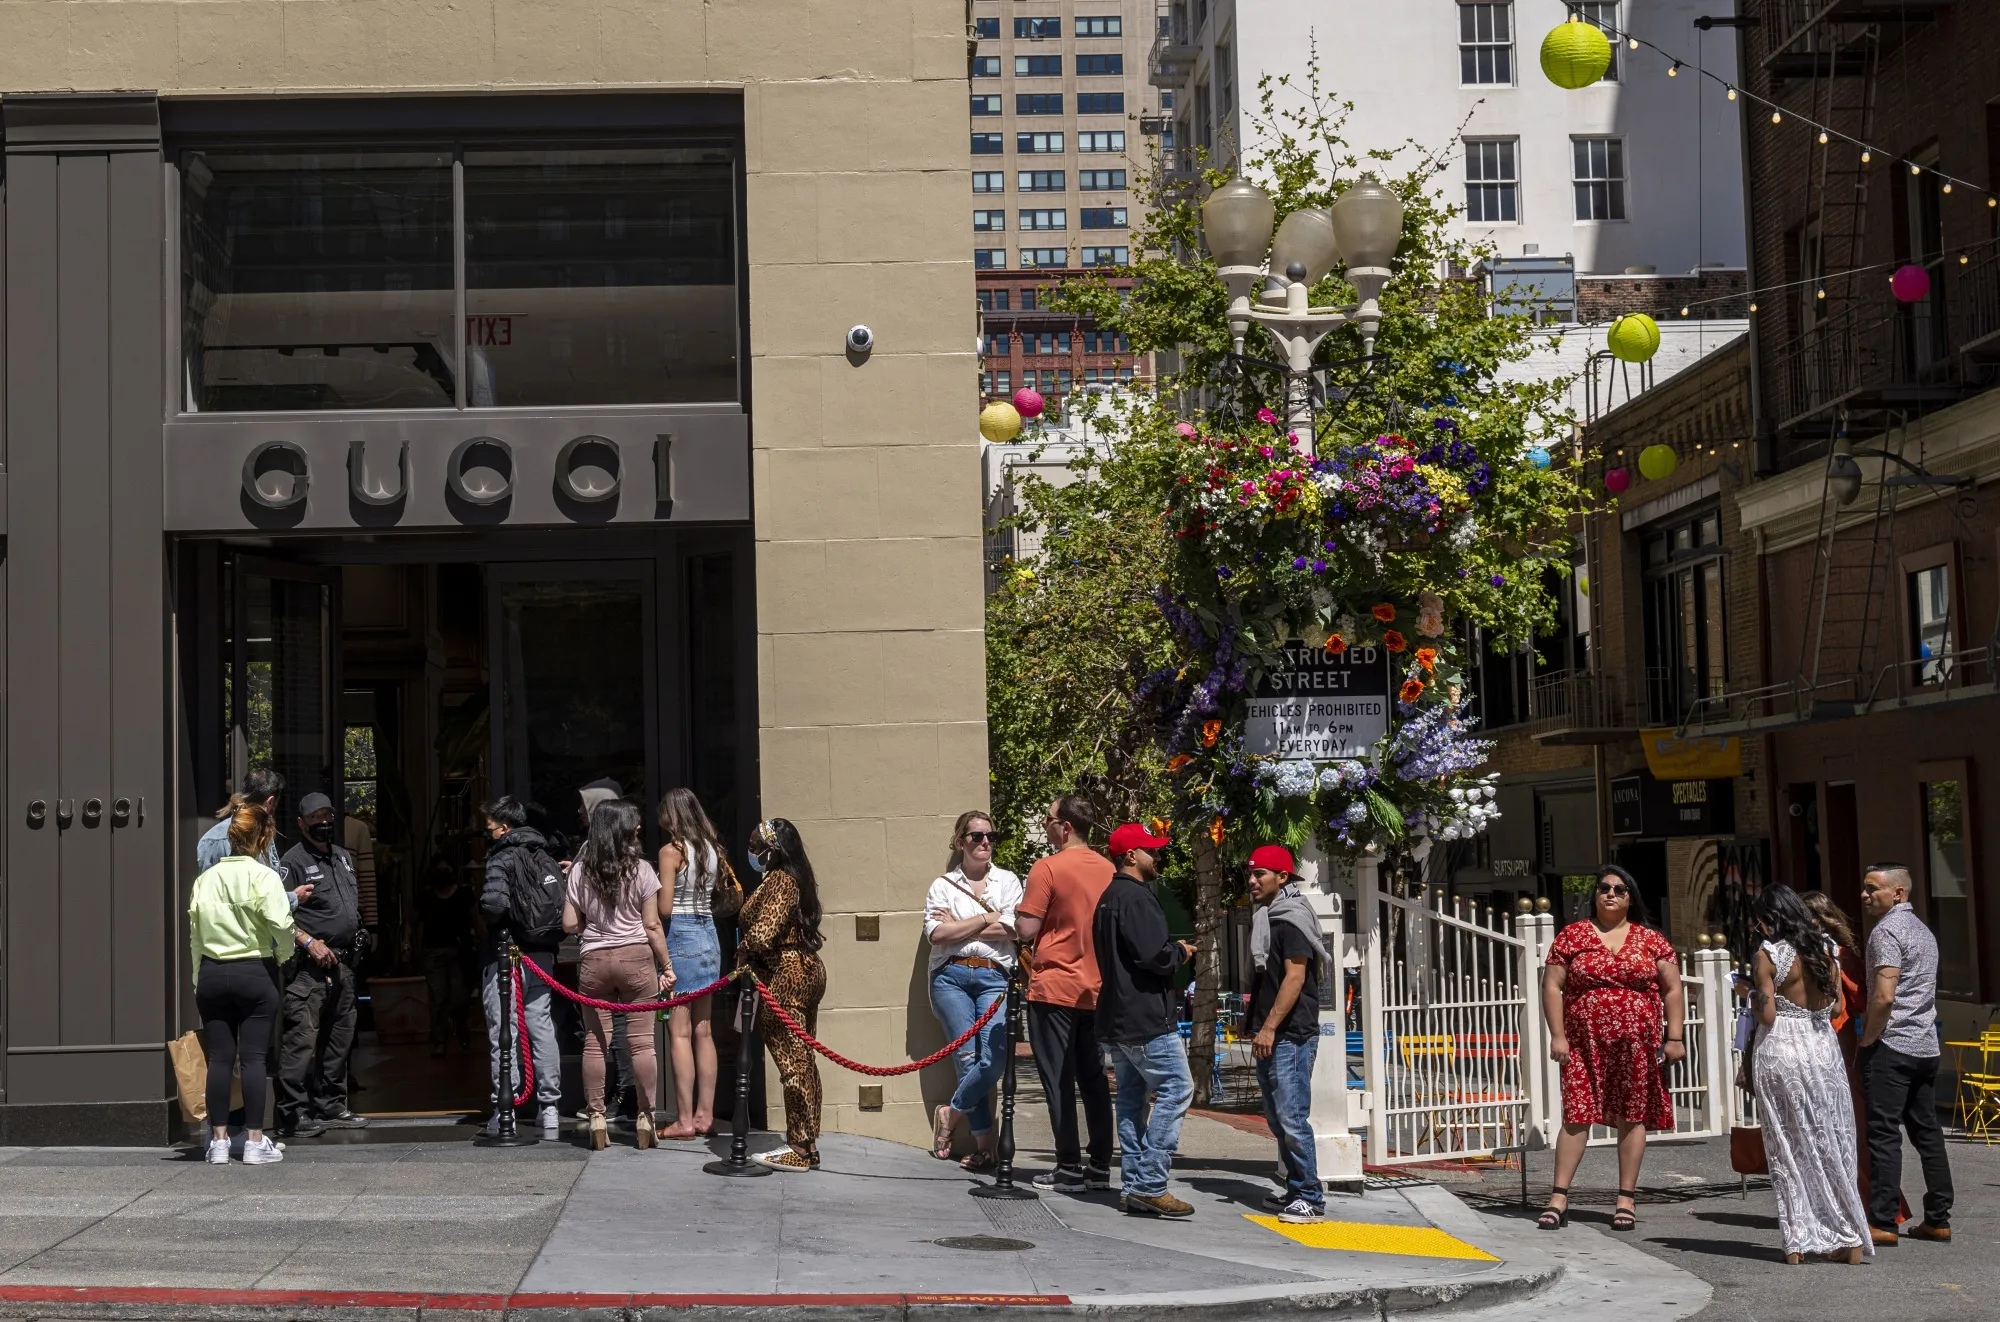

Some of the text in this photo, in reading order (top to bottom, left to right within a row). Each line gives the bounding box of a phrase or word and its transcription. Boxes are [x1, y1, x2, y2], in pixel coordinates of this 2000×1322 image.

[241, 433, 672, 509] GUCCI
[1271, 670, 1351, 690] STREET
[1250, 702, 1381, 718] EHICLES PROHIBITED
[1272, 721, 1354, 736] 11AM TO 6PM
[1279, 739, 1347, 752] EVERYDAY
[1613, 788, 1639, 803] ANCONA
[1673, 781, 1706, 803] SPECTACLES
[27, 798, 145, 820] GUCCI
[1494, 859, 1530, 877] SUITSUPPLY
